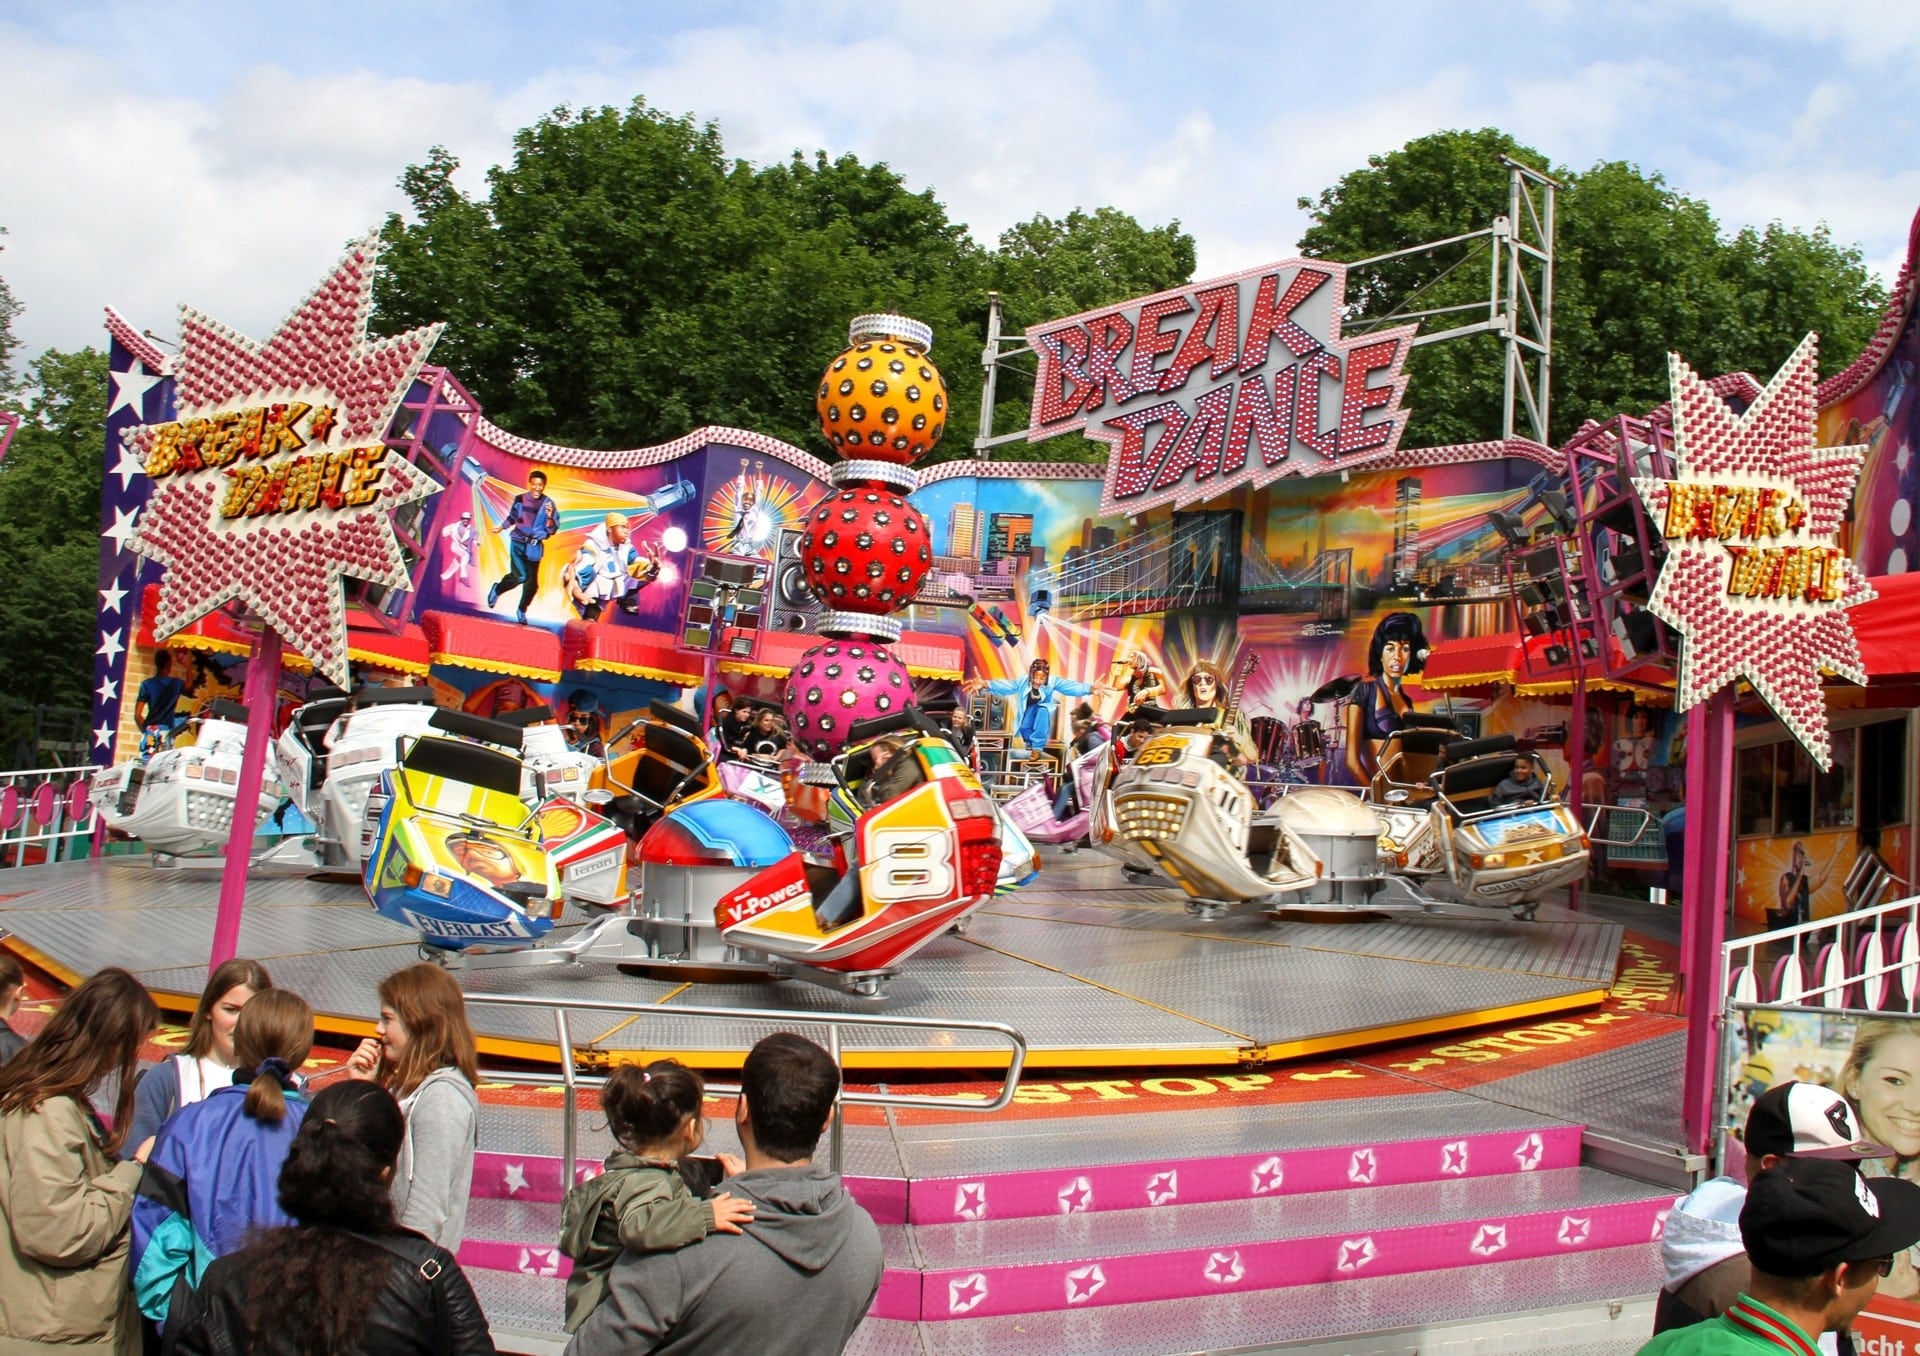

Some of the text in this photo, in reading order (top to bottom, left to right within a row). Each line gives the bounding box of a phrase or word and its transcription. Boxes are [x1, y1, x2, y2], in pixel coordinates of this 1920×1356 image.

[1039, 268, 1332, 425] BREAK
[147, 402, 307, 478] BREAK
[1103, 338, 1400, 499] DANCE
[219, 445, 388, 519] DANCE
[1664, 482, 1787, 541] BREAK
[1722, 545, 1845, 602] DANCE
[1137, 748, 1175, 764] 66
[574, 857, 613, 876] Ferrari
[870, 827, 955, 904] 8
[411, 912, 521, 937] EVERLAST
[727, 879, 805, 922] V-Power
[1431, 1021, 1597, 1063] STOP
[999, 1074, 1275, 1105] STOP
